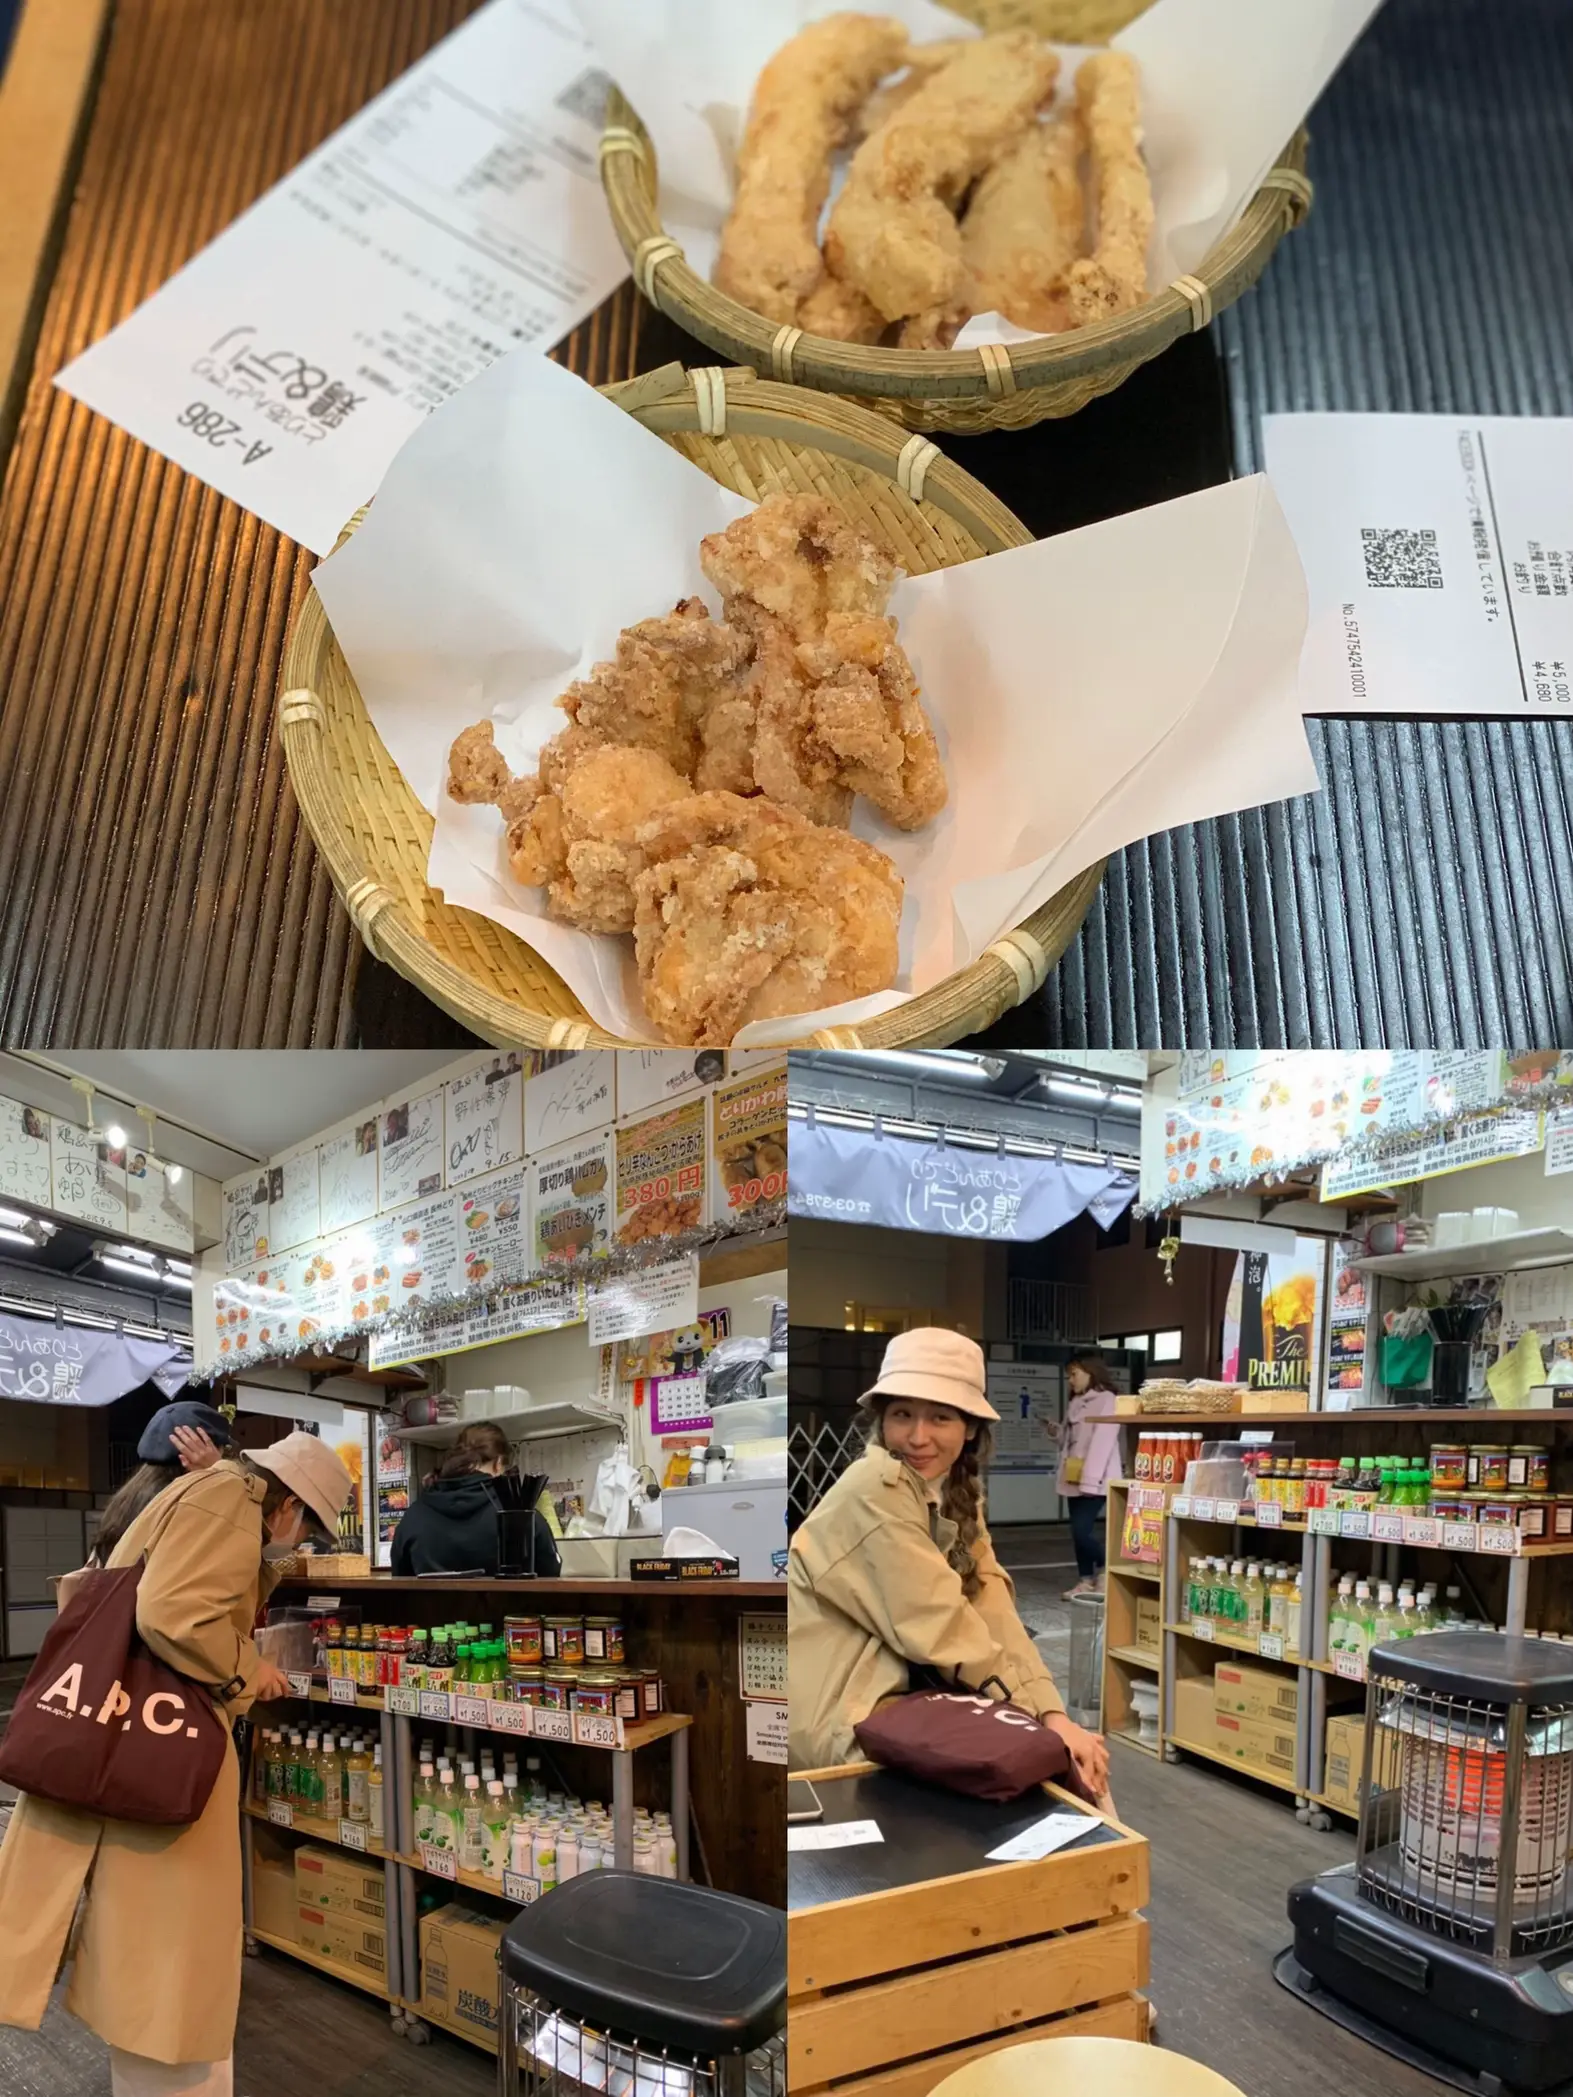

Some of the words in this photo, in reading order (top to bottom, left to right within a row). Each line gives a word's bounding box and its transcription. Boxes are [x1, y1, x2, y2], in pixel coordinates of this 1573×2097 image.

[176, 401, 273, 465] A-286
[1513, 562, 1532, 595] お釣り
[1342, 603, 1366, 699] No.5747542410001
[1532, 661, 1552, 703] ¥4,680
[1551, 661, 1571, 703] ¥5,000
[709, 1309, 728, 1338] 11
[1276, 1334, 1305, 1359] The
[682, 1566, 698, 1576] BLACK
[36, 1702, 74, 1720] www.apc.fr
